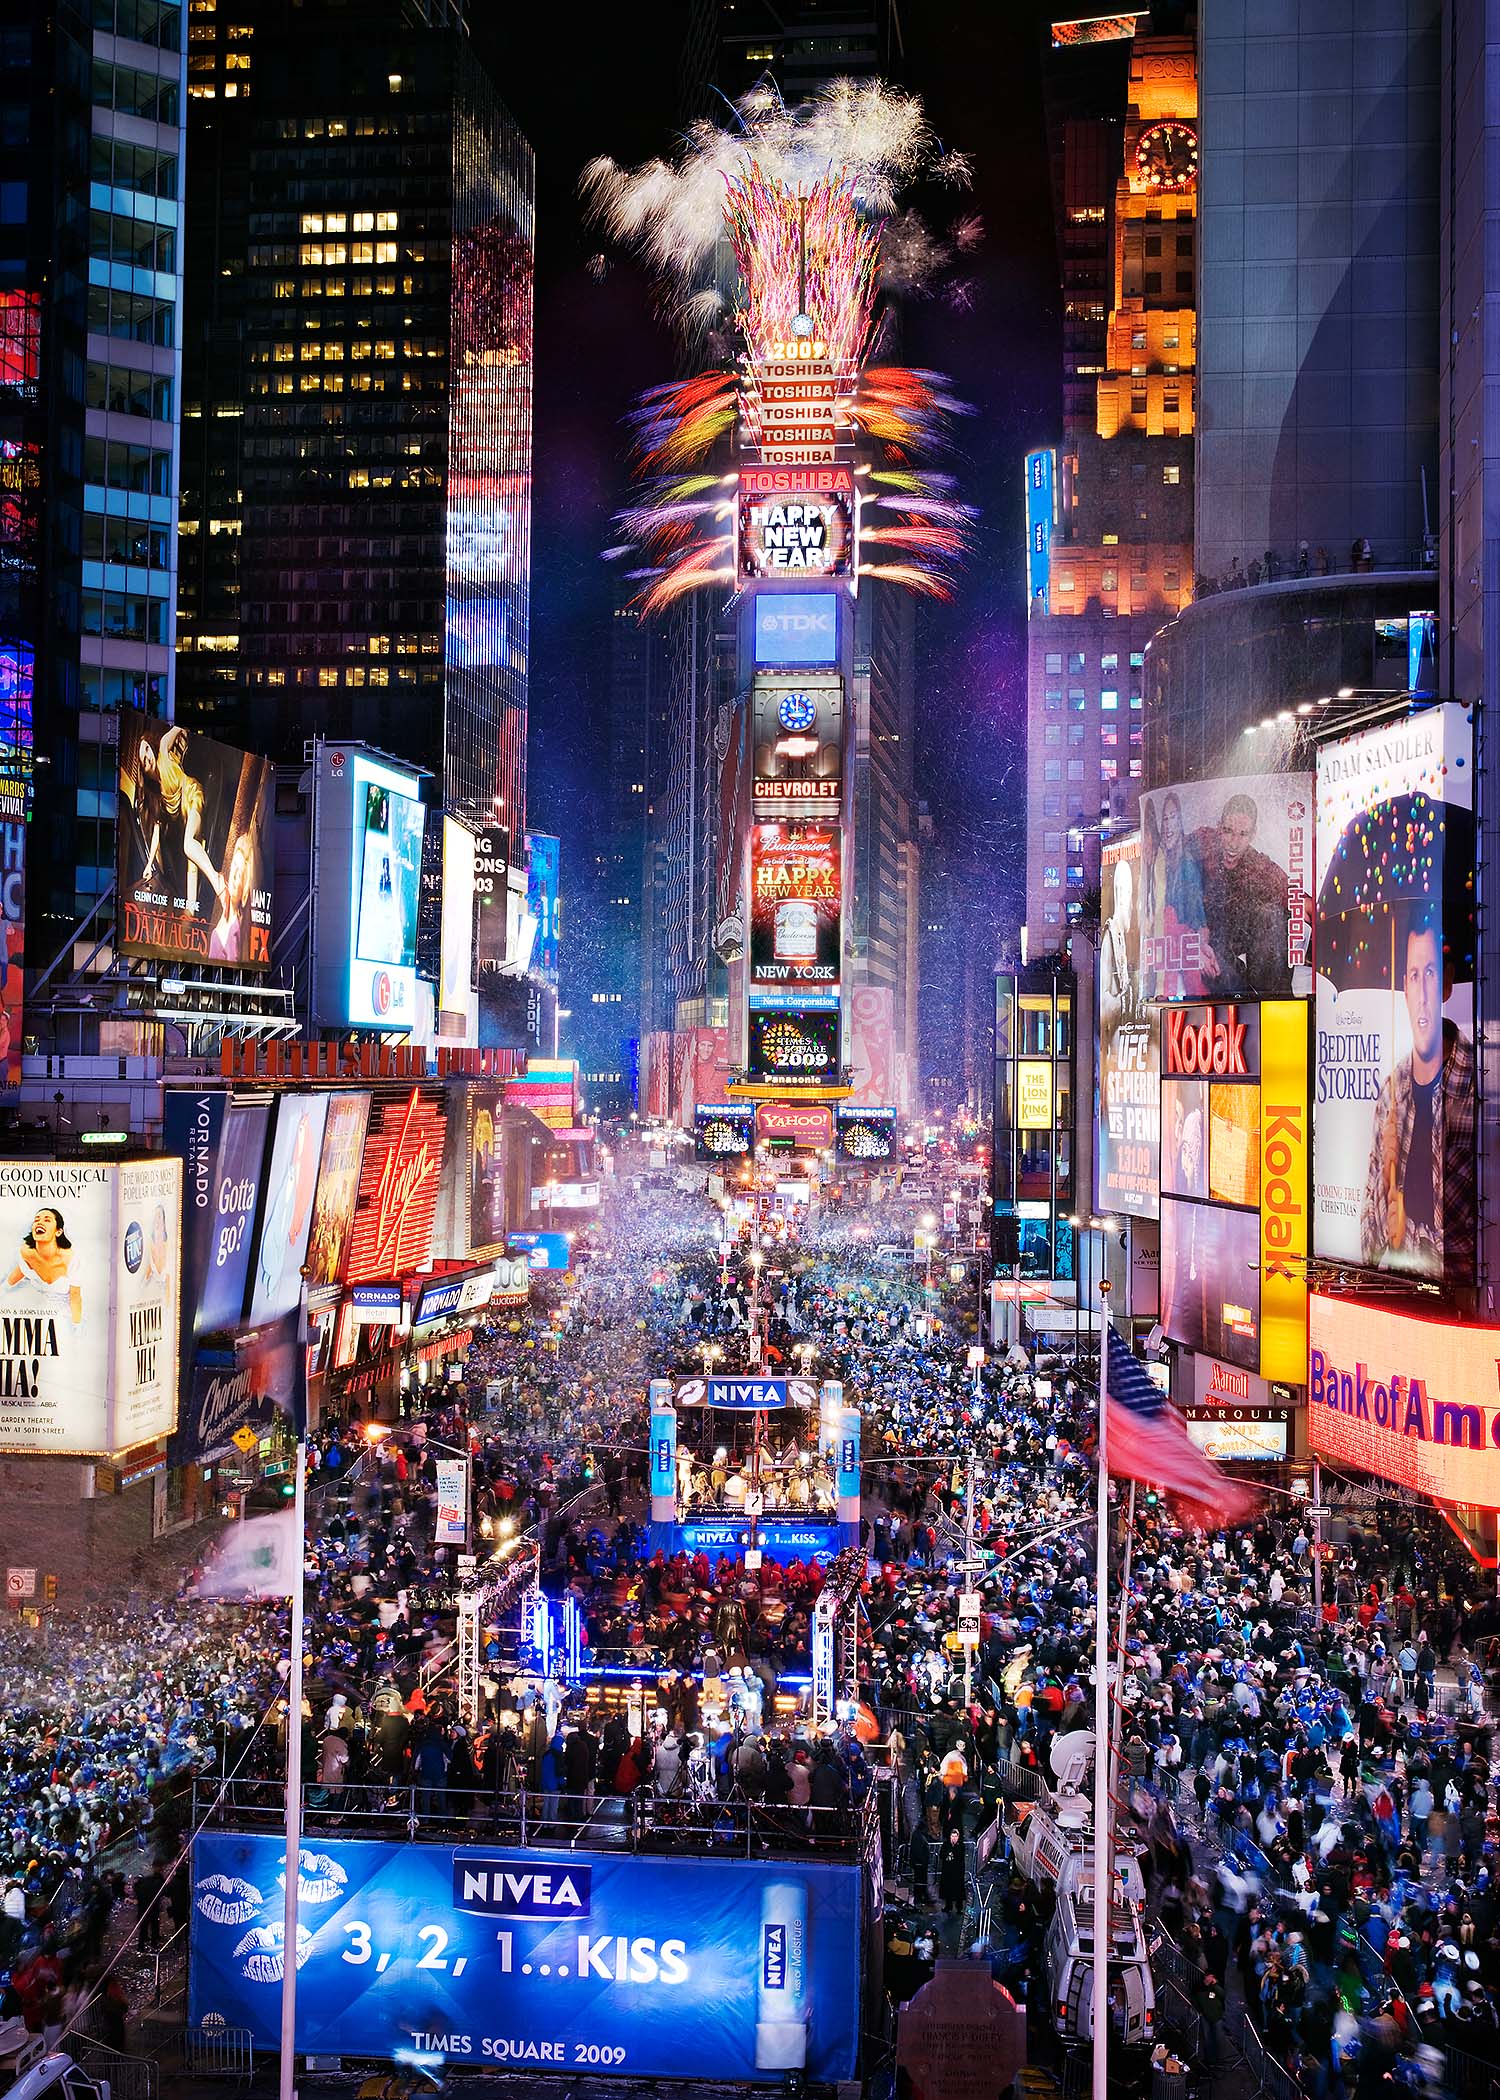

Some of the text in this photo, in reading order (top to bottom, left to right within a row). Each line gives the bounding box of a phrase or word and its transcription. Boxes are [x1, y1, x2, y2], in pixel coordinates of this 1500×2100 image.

[773, 341, 825, 359] 2009
[765, 364, 833, 376] TOSHIBA
[764, 386, 833, 398] TOSHIBA
[764, 407, 833, 419] TOSHIBA
[764, 428, 833, 442] TOSHIBA
[764, 451, 832, 463] TOSHIBA
[741, 472, 851, 491] TOSHIBA
[751, 505, 839, 526] HAPPY
[764, 527, 824, 547] NEW
[755, 548, 833, 568] YEAR!
[777, 615, 829, 631] TDK
[1322, 730, 1434, 785] ADAM SANDLER
[755, 782, 838, 796] CHEVROLET
[759, 834, 831, 852] Budweiser
[757, 868, 835, 884] HAPPY
[251, 889, 272, 910] JAN 7
[757, 885, 835, 897] NEW YEAR
[1288, 827, 1305, 968] SOUTHPOLE
[123, 902, 208, 956] DAMAGES
[250, 927, 270, 962] FX
[1143, 933, 1201, 974] POLE
[756, 966, 834, 979] NEW YORK
[527, 989, 536, 1032] 1500
[763, 997, 836, 1008] News Corporation
[779, 1038, 811, 1046] TIMES
[1168, 1005, 1248, 1074] Kodak
[1319, 1031, 1381, 1064] BEDTIME
[784, 1045, 827, 1054] SQUARE
[1118, 1034, 1149, 1071] UFC
[778, 1054, 828, 1066] 2009
[765, 1075, 821, 1084] Panasonic
[1025, 1074, 1044, 1084] THE
[1318, 1065, 1380, 1104] STORIES
[697, 1104, 752, 1114] Panasonic
[839, 1107, 894, 1117] Panasonic
[1022, 1103, 1048, 1119] KING
[760, 1113, 827, 1128] YAHOO!
[1127, 1107, 1160, 1143] PENN
[196, 1097, 210, 1208] VORNADO
[714, 1142, 749, 1152] 2009
[854, 1146, 890, 1156] 2009
[1, 1168, 109, 1183] GOOD MUSICAL
[218, 1177, 256, 1215] Gotta
[1265, 1106, 1301, 1283] Kodak
[1317, 1183, 1360, 1202] COMING TRUE
[1321, 1200, 1357, 1217] CHRISTMAS
[216, 1216, 246, 1267] go?
[353, 1292, 400, 1300] VORNADO
[420, 1288, 462, 1318] VORNADO
[0, 1358, 39, 1398] IA!
[1210, 1363, 1249, 1399] Marriott
[714, 1385, 781, 1401] NIVEA
[1311, 1349, 1500, 1451] Bank of Am
[1, 1416, 25, 1424] GARDEN
[1187, 1410, 1288, 1419] MARQUIS
[659, 1441, 668, 1470] NIVEA
[697, 1533, 735, 1543] NIVEA
[463, 1870, 582, 1907] NIVEA
[341, 1921, 391, 1972] 3,
[416, 1925, 468, 1977] 2,
[792, 1919, 802, 1968] Moisture
[767, 1928, 781, 1986] NIVEA
[410, 2032, 626, 2065] TIMES SQUARE 2009
